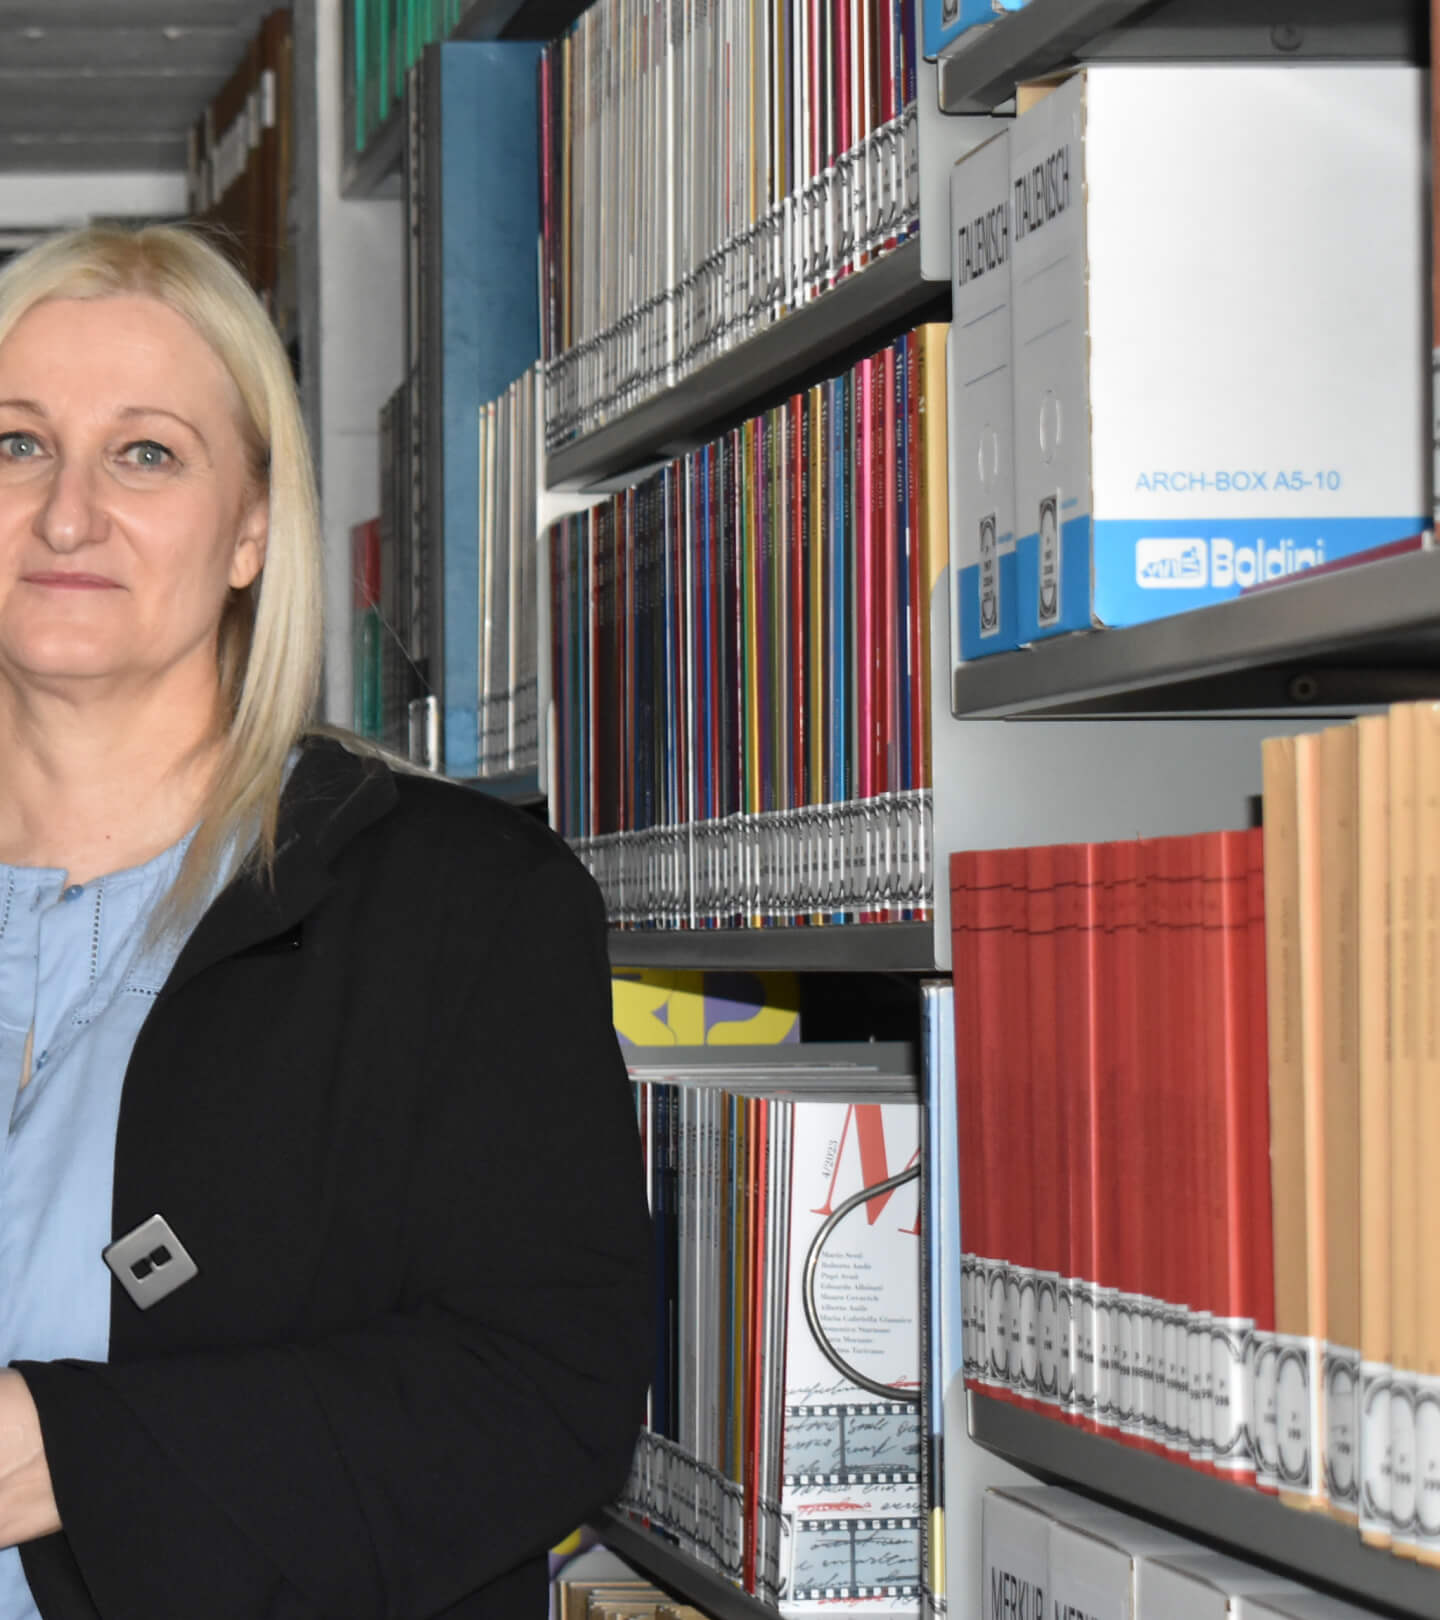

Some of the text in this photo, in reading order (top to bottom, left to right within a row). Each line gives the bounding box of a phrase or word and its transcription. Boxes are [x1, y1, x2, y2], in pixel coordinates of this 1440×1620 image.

[1135, 469, 1342, 492] ARCH-BOX A5-10
[1211, 538, 1326, 588] Boldini
